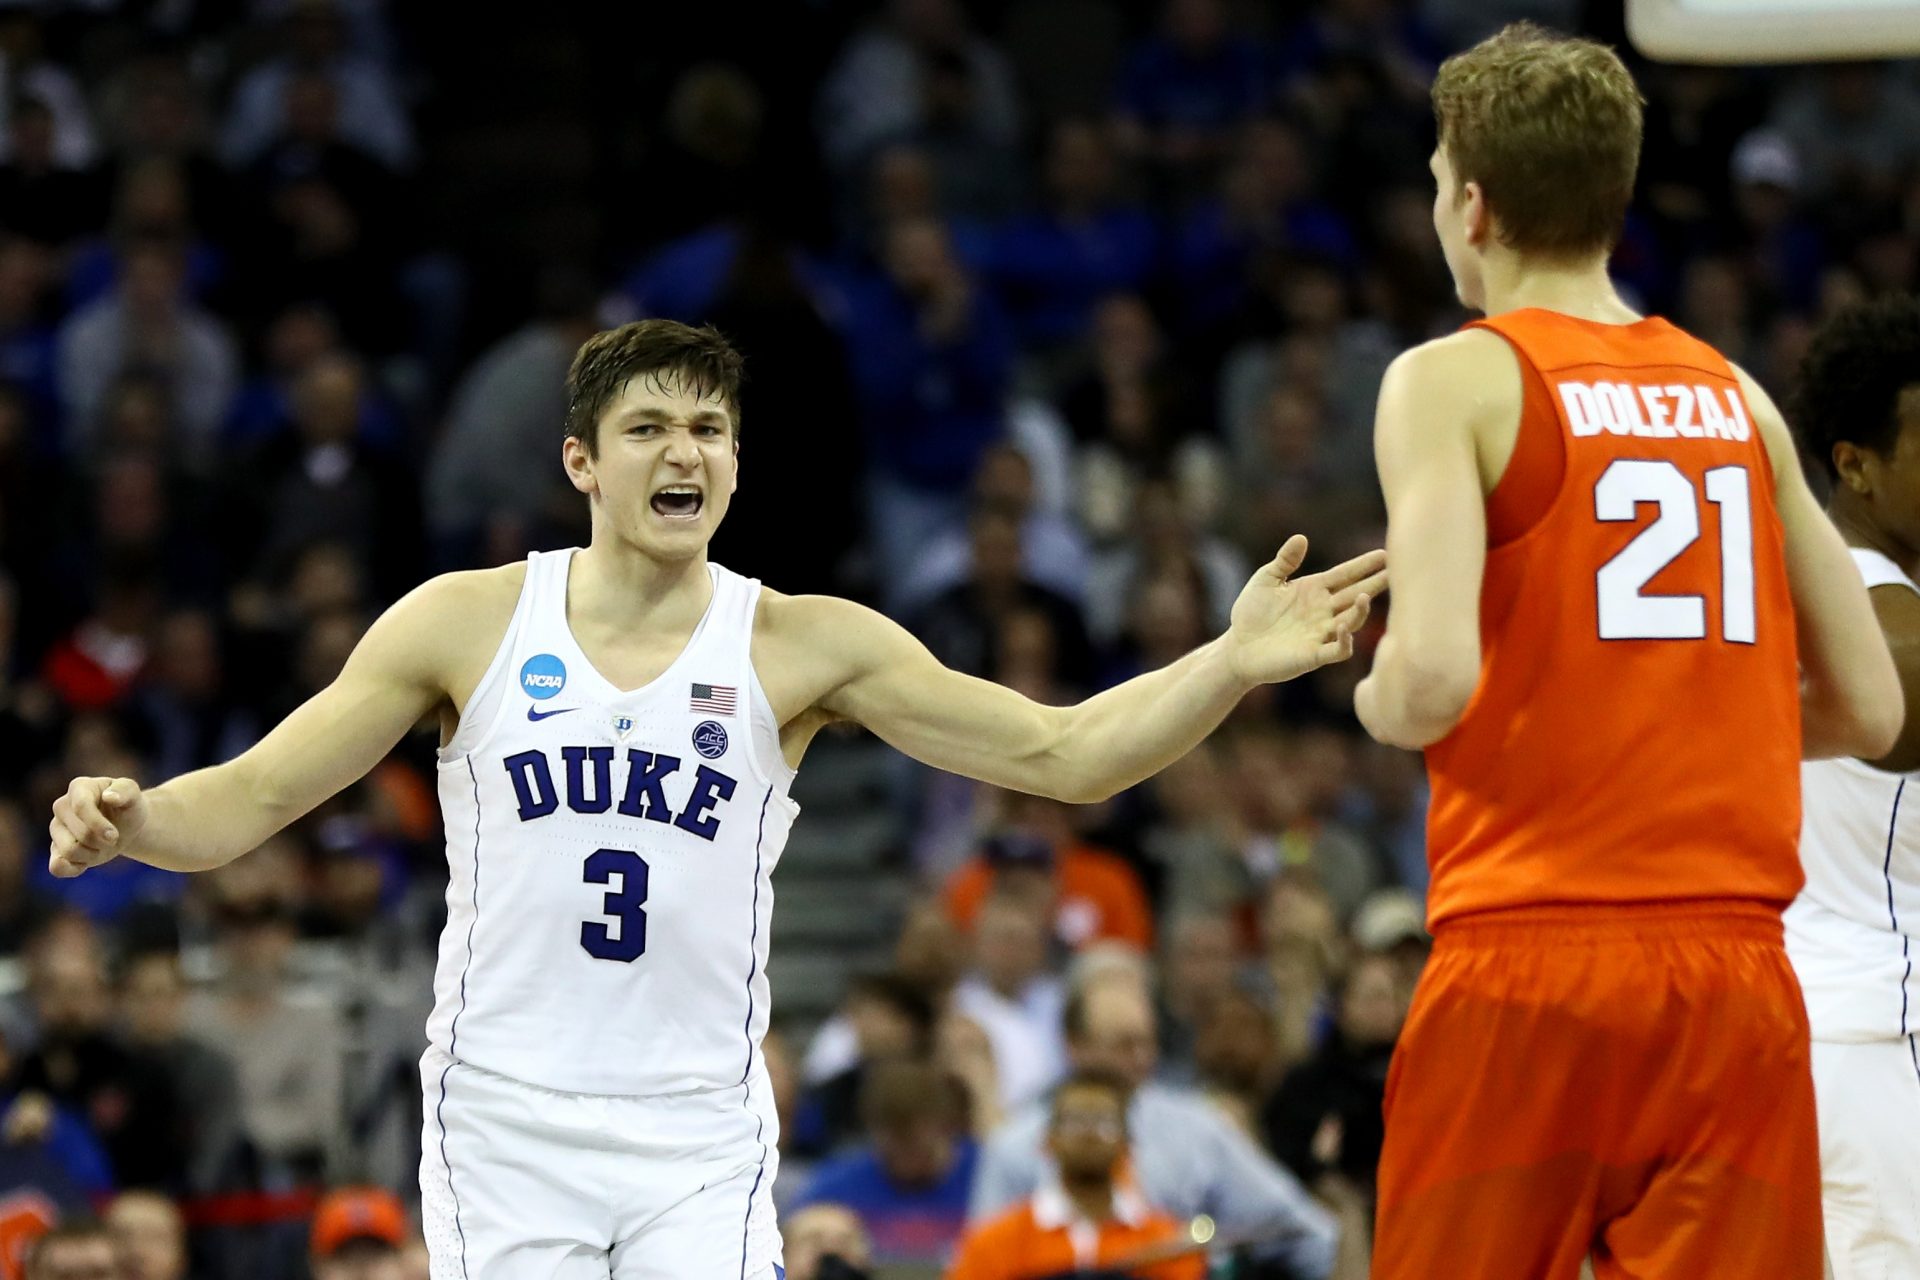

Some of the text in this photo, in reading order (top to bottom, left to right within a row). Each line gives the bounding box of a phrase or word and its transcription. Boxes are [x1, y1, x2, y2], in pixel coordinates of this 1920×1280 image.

[1557, 381, 1751, 442] DOLEZAJ
[1594, 457, 1757, 645] 21
[525, 673, 563, 688] NCAA
[698, 732, 726, 745] ACC
[503, 746, 738, 842] DUKE
[580, 848, 649, 963] 3
